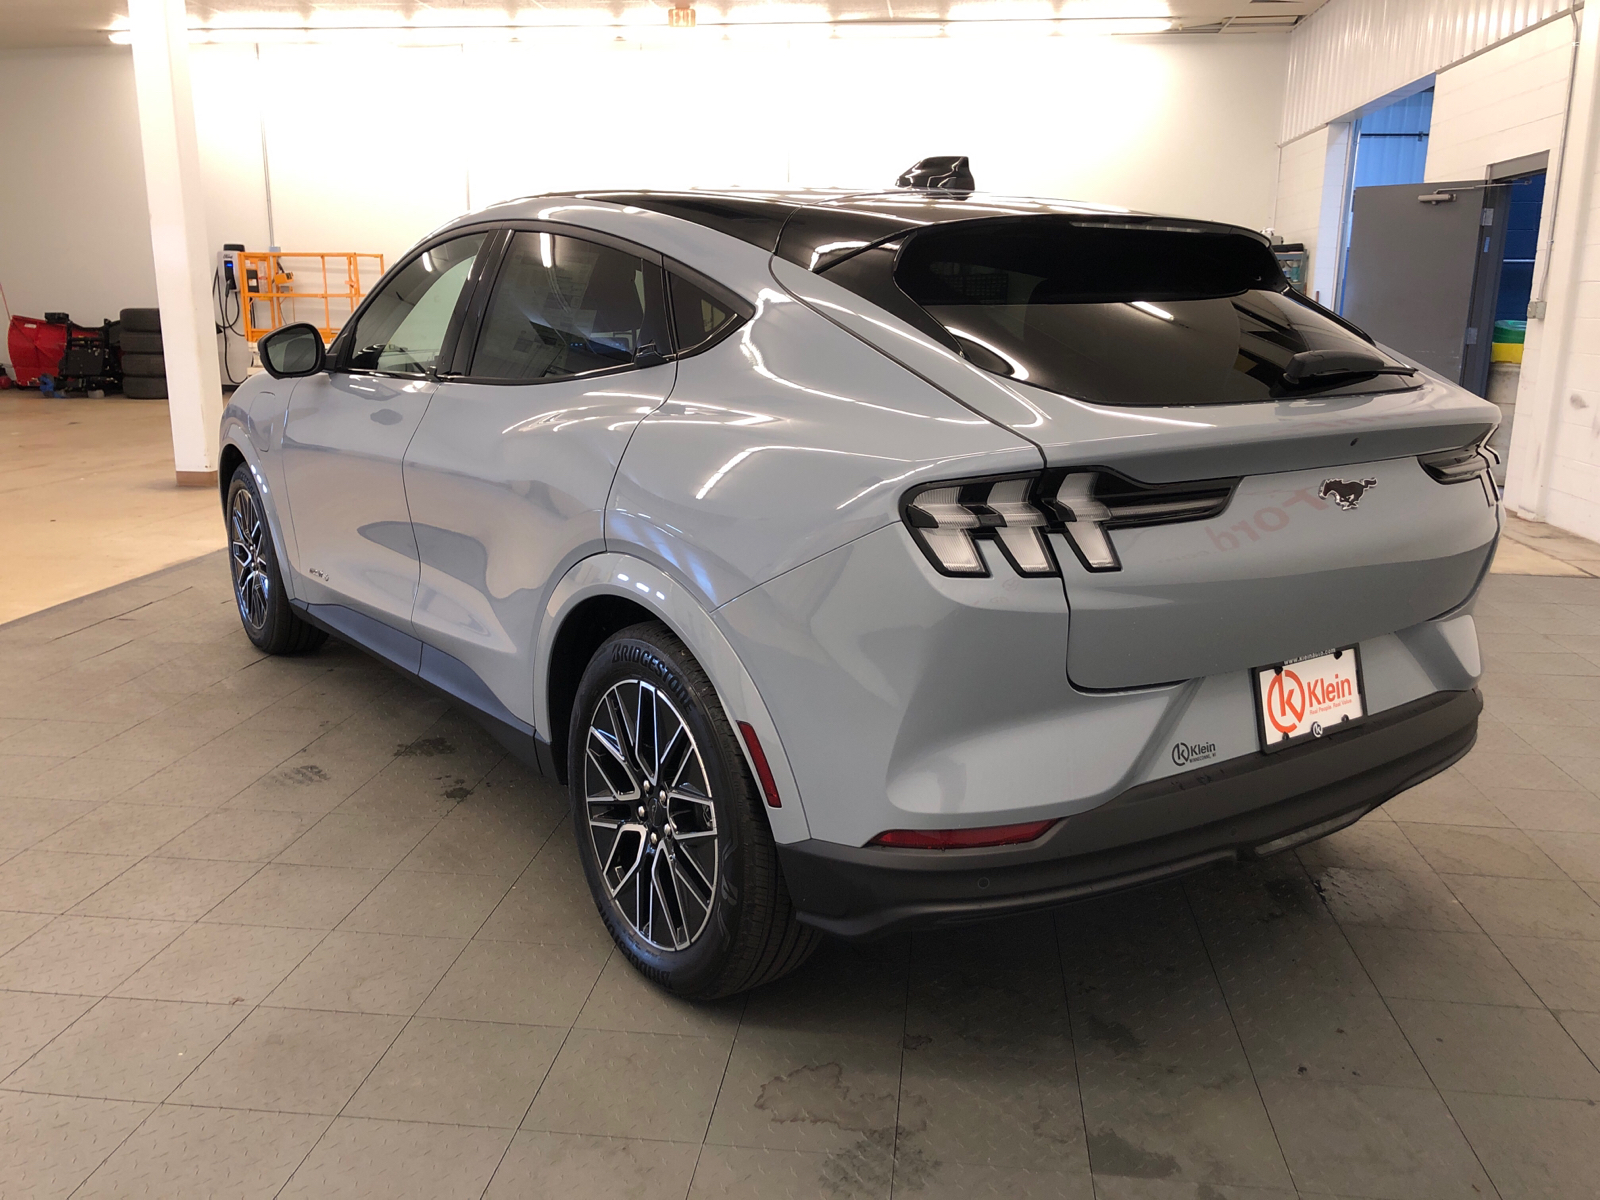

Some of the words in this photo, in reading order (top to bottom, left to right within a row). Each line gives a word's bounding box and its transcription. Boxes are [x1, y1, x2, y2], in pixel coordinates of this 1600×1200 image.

[611, 643, 698, 715] BRIDGESTONE
[1307, 673, 1352, 708] Klein
[1190, 742, 1216, 757] Klein
